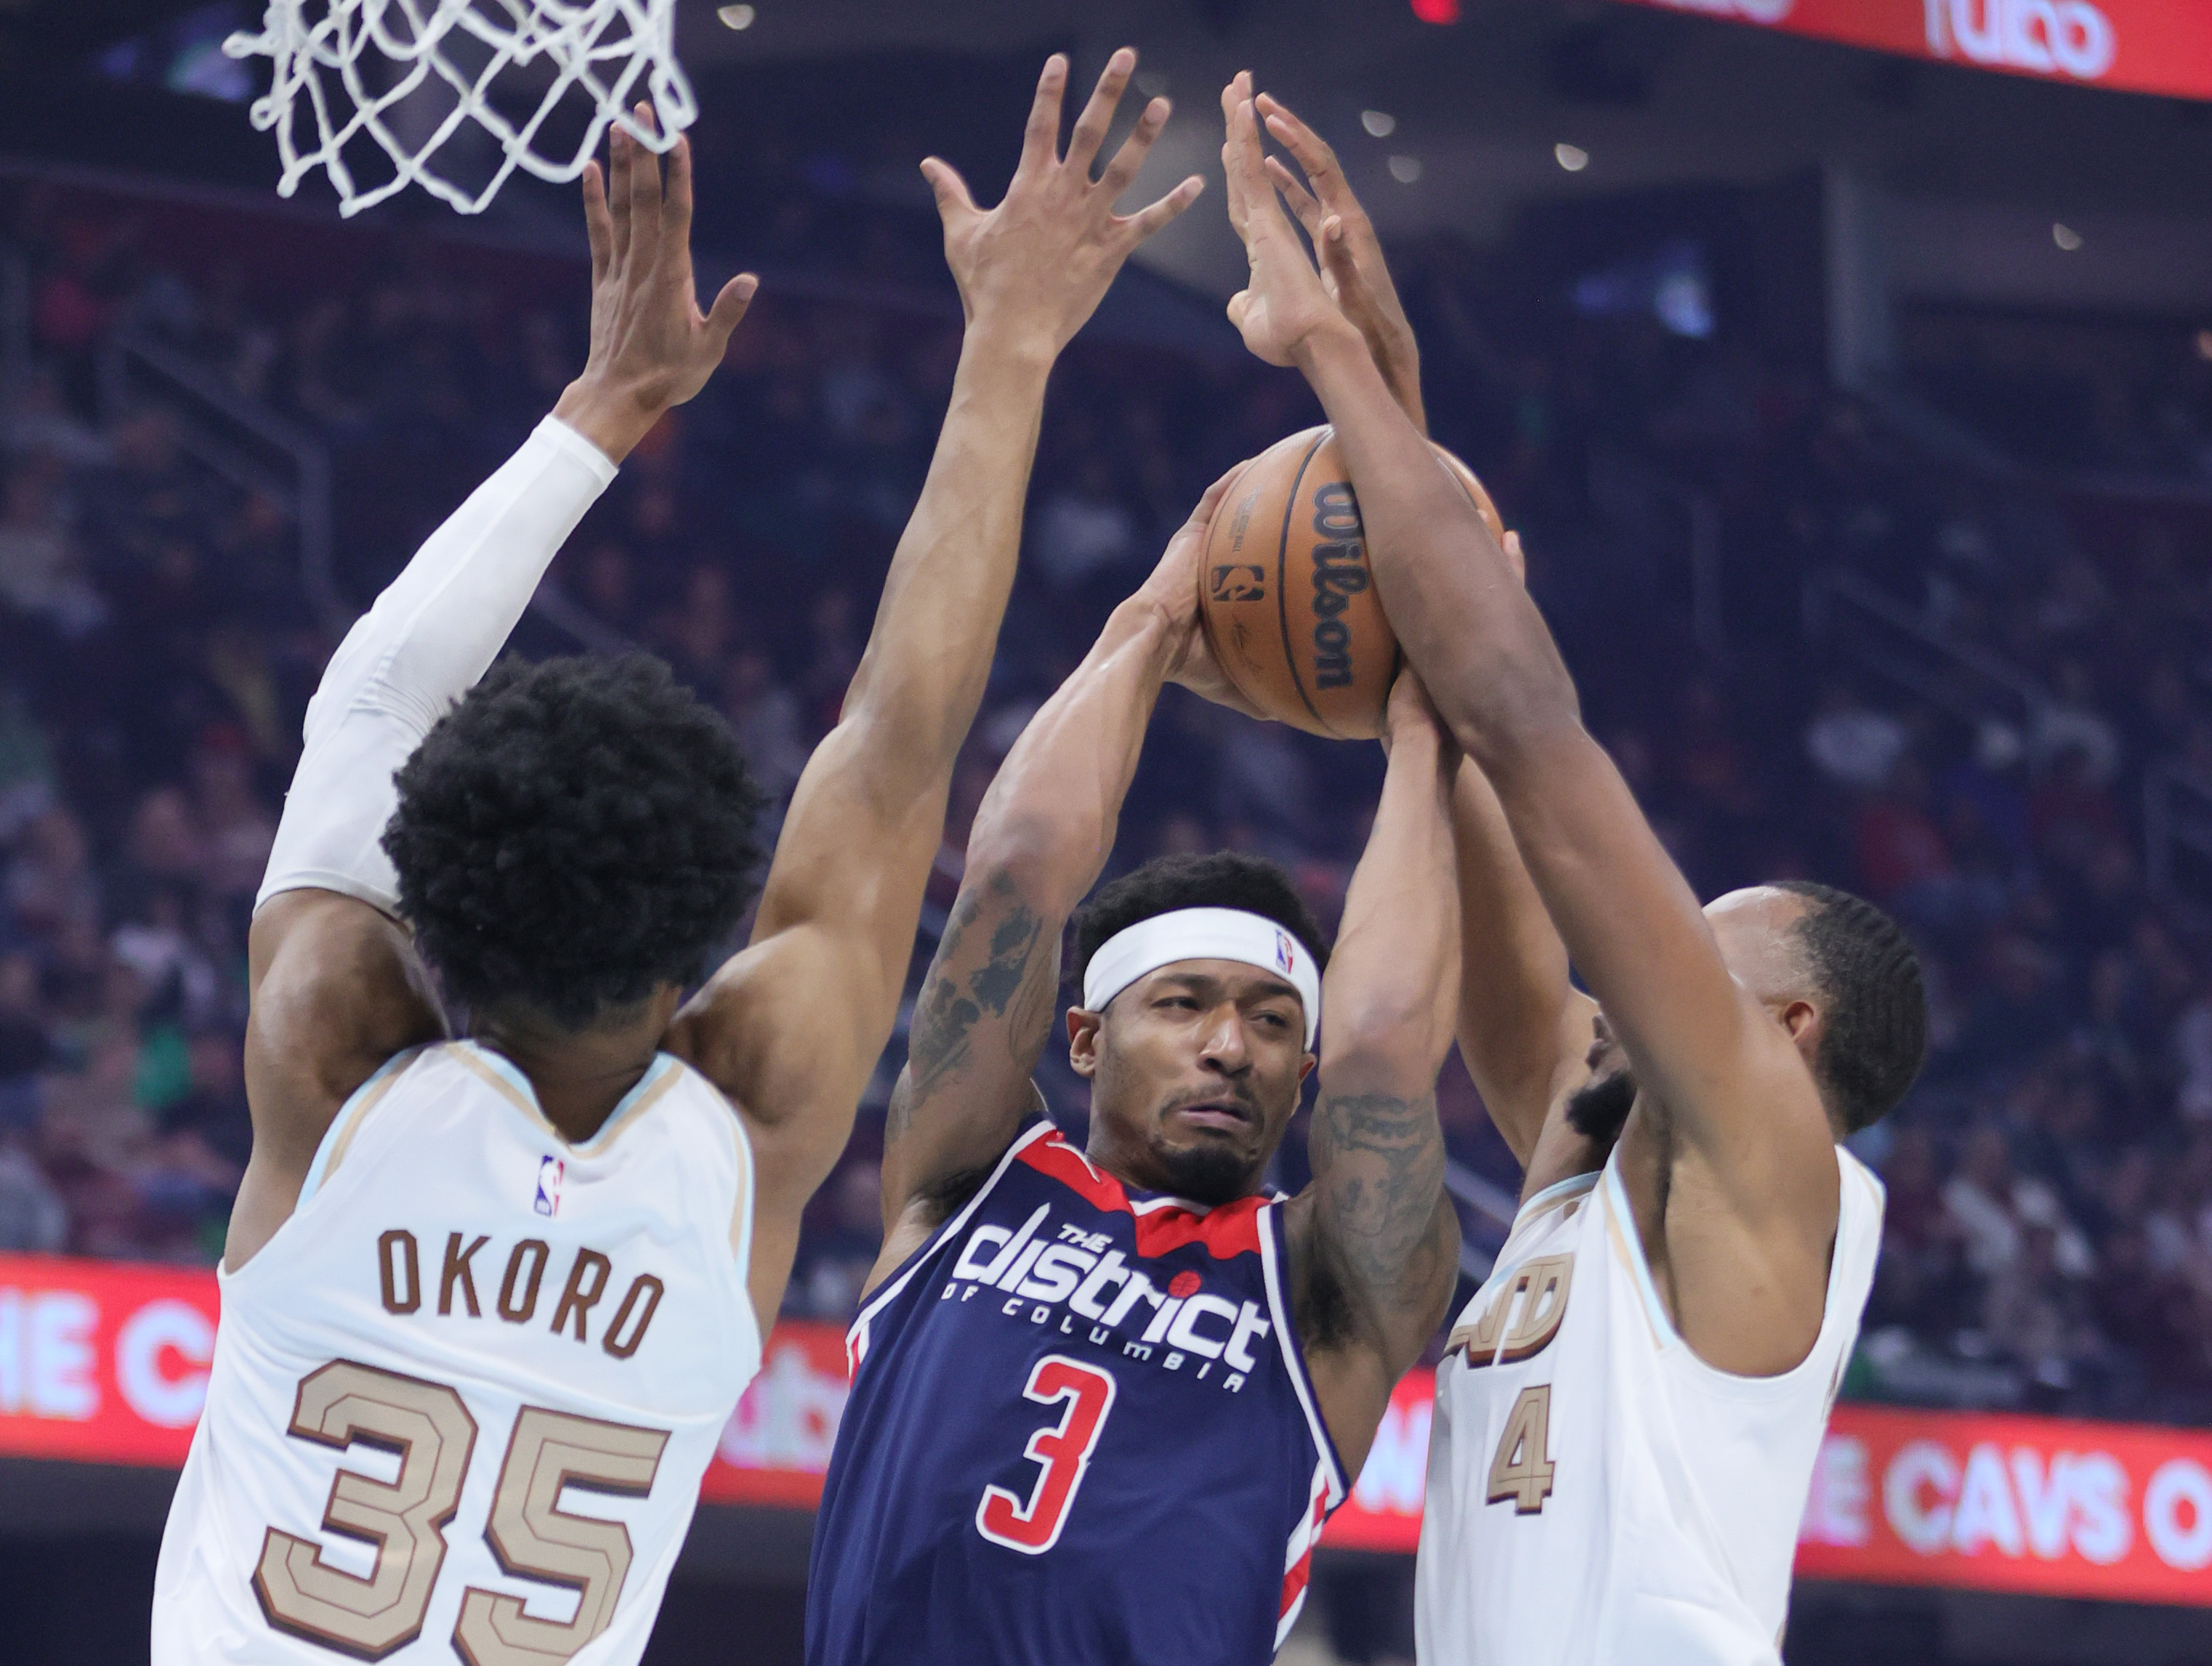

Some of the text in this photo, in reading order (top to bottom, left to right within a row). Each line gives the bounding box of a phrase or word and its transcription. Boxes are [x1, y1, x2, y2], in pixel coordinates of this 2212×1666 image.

[1312, 481, 1369, 690] Wilson
[377, 1229, 665, 1360] OKORO
[941, 1282, 980, 1303] OF
[952, 1202, 1271, 1374] district
[1057, 1223, 1114, 1254] THE
[250, 1357, 672, 1666] 35
[975, 1354, 1118, 1555] 3
[1486, 1383, 1556, 1516] 4
[1882, 1436, 2134, 1566] CAVS
